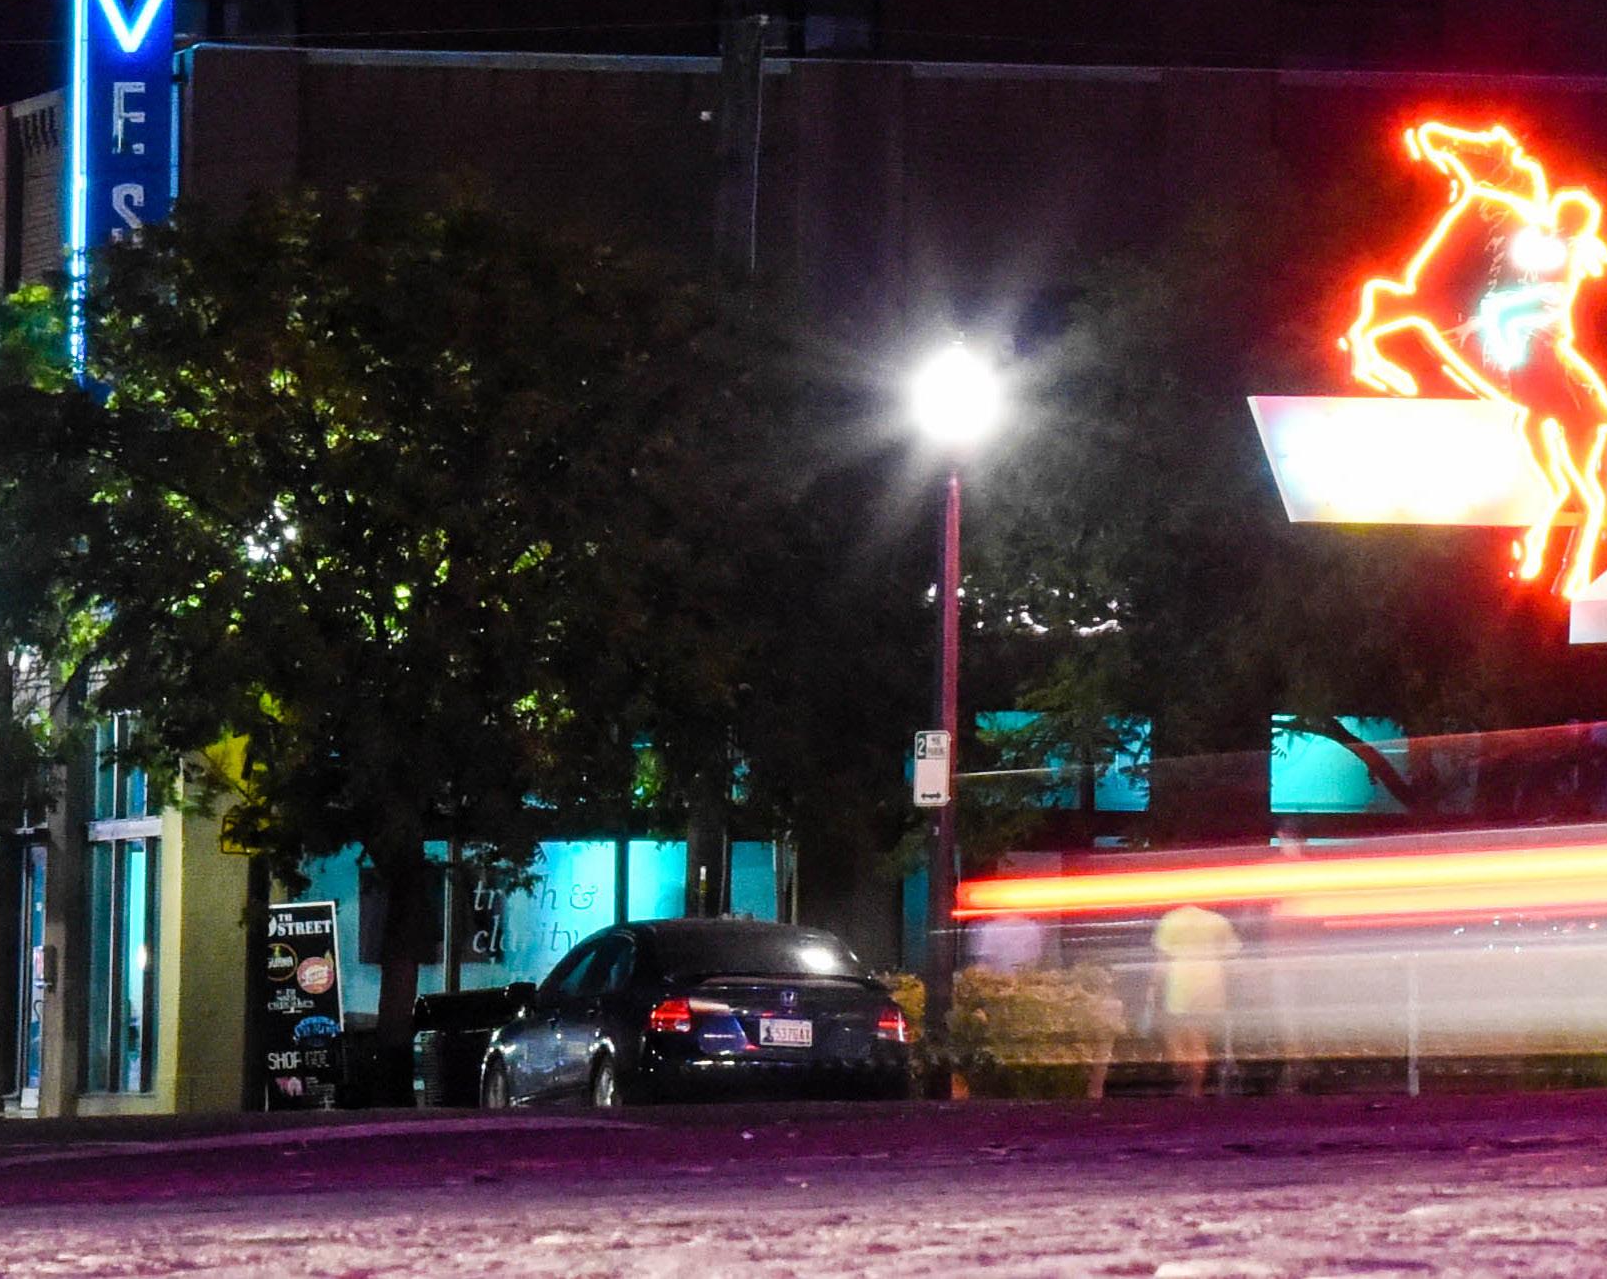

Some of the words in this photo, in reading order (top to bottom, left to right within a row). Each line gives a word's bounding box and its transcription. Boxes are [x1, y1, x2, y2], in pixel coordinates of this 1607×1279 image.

[918, 738, 925, 756] 2
[473, 874, 557, 910] trh
[277, 920, 331, 936] STREET
